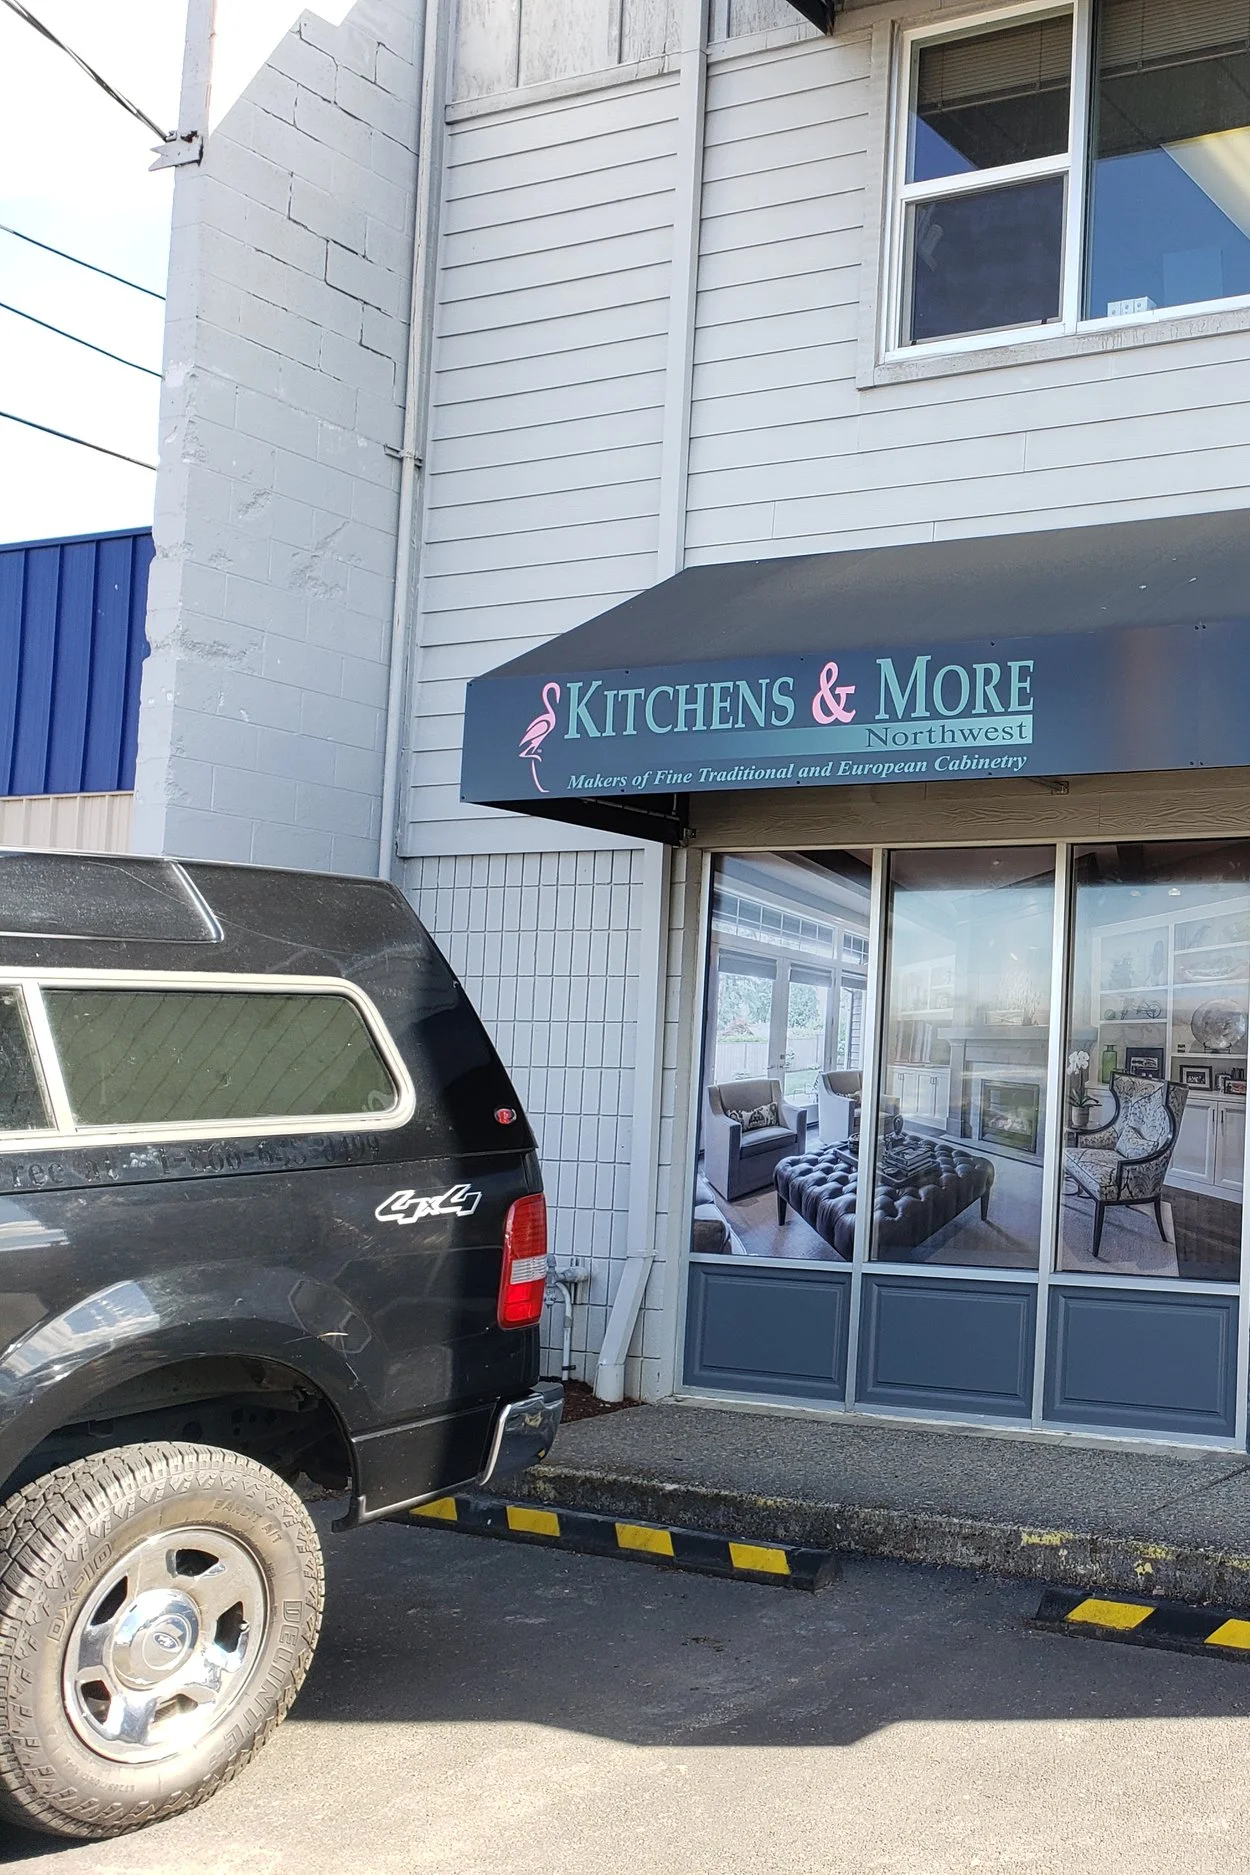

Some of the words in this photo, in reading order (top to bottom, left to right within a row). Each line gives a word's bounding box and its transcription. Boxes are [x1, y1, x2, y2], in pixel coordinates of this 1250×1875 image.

[564, 676, 795, 740] KITCHENS
[811, 661, 856, 725] &
[874, 655, 1034, 720] MORE
[865, 720, 1028, 748] Northwest
[567, 773, 628, 790] Makers
[631, 770, 653, 790] of
[653, 768, 693, 785] Fine
[698, 763, 793, 782] Traditional
[798, 760, 833, 778] and
[836, 758, 928, 778] European
[934, 754, 1028, 772] Cabinetry
[374, 1183, 483, 1225] 4x4
